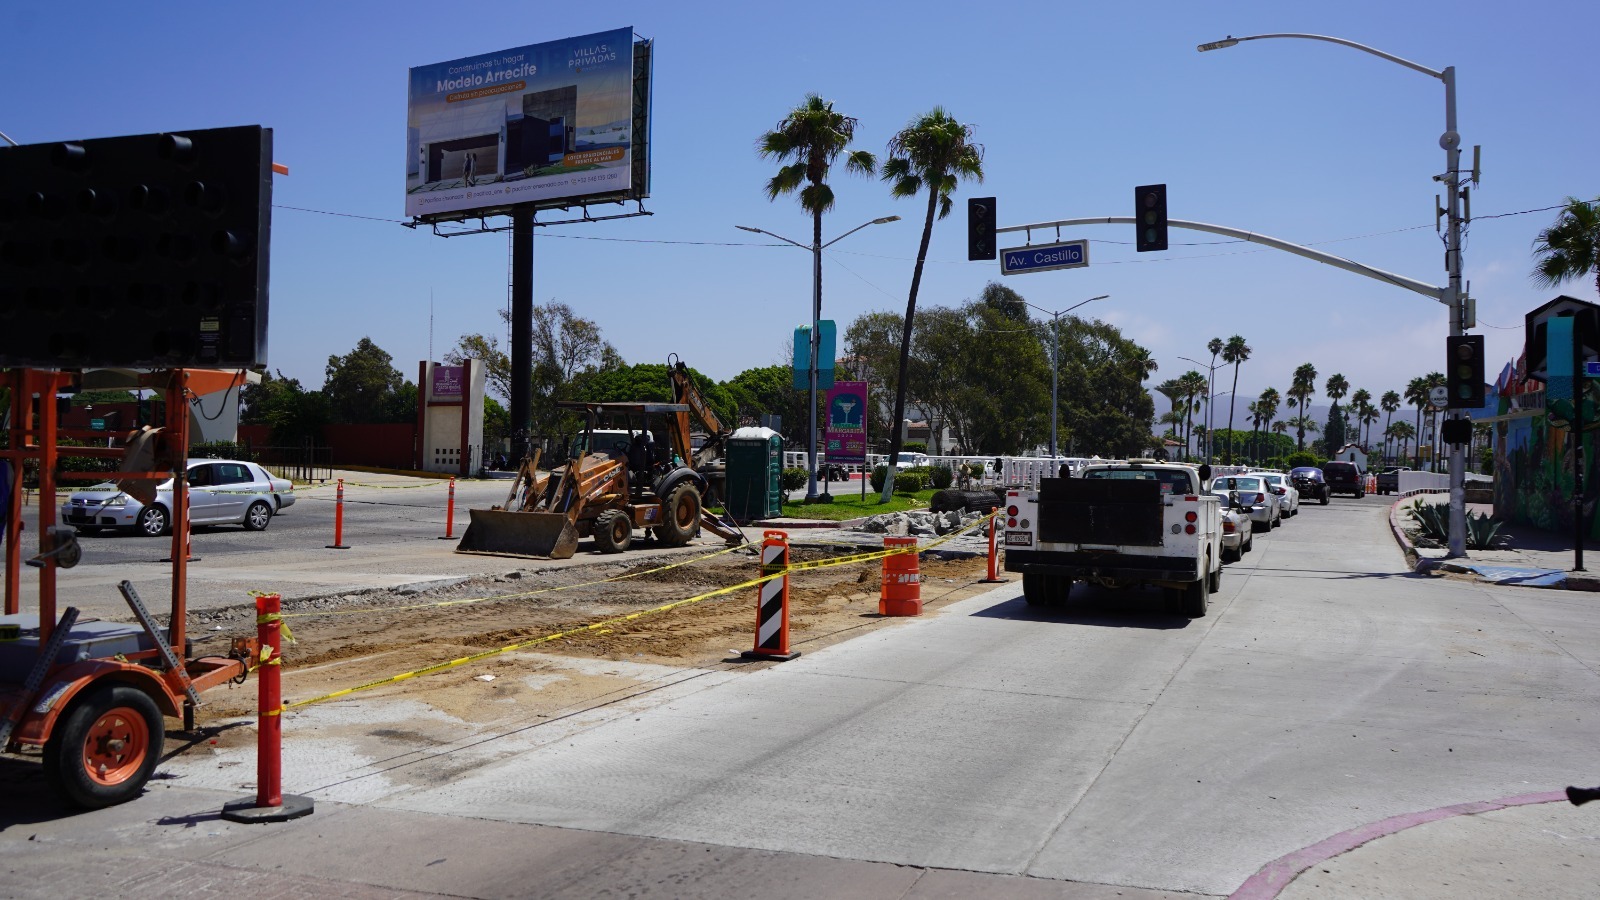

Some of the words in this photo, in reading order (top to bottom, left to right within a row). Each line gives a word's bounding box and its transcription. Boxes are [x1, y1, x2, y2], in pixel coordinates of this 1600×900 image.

[574, 45, 606, 57] VILLAS
[448, 60, 493, 75] Construimos
[502, 54, 524, 65] hogar
[568, 52, 616, 68] PRIVADAS
[437, 73, 483, 92] Modelo
[485, 63, 537, 83] Arrecife
[1009, 256, 1027, 266] Av.
[1034, 250, 1079, 264] Castillo
